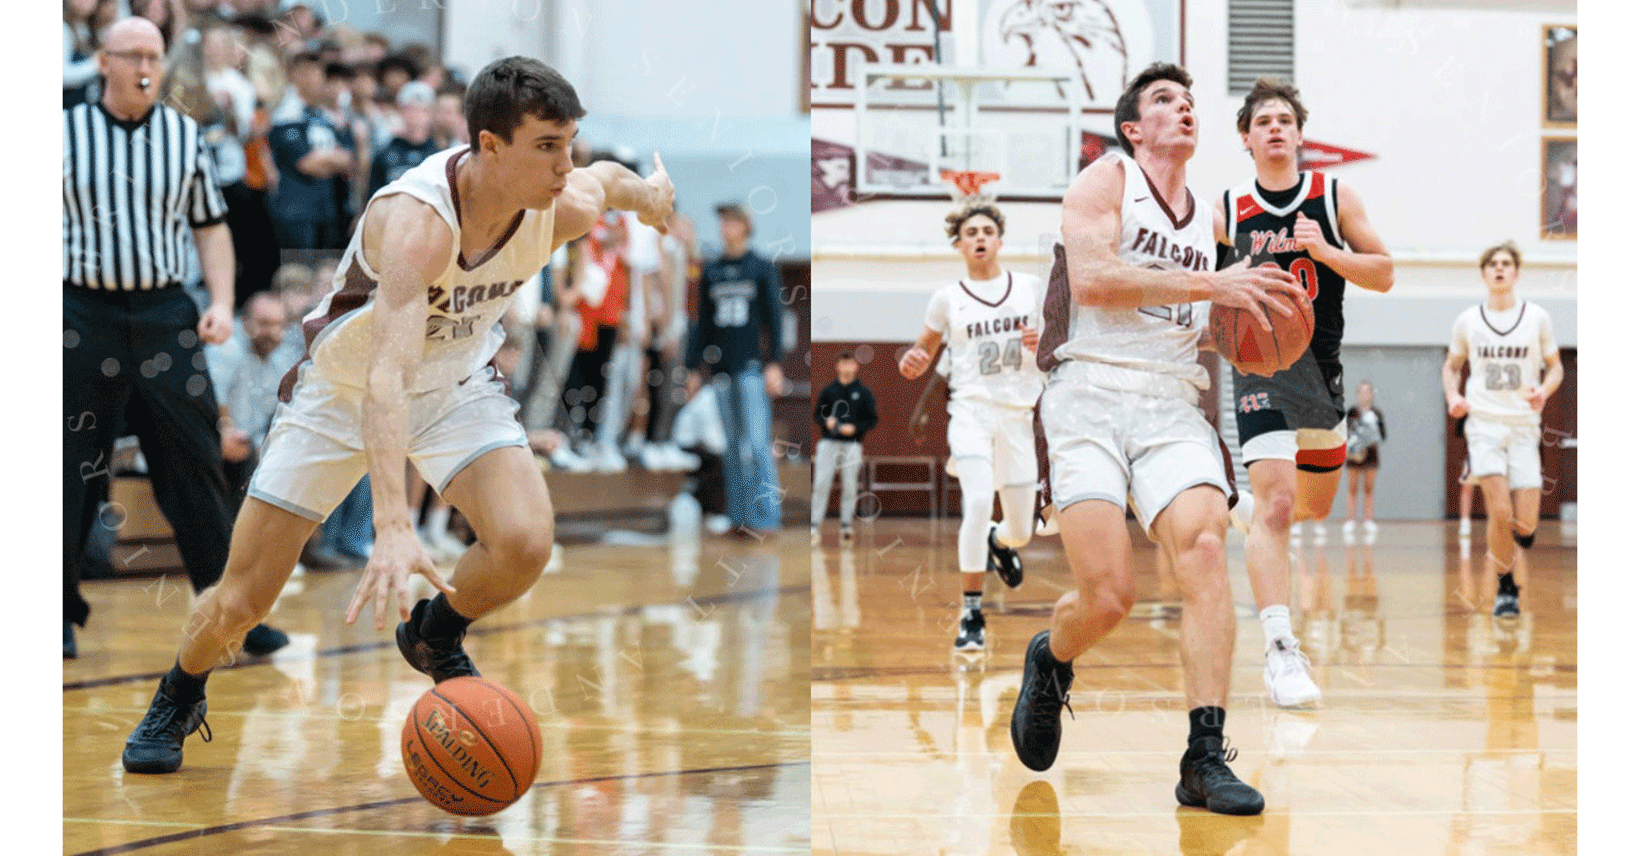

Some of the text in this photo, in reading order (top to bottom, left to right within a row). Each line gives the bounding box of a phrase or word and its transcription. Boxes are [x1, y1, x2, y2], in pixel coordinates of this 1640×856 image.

[811, 43, 935, 91] DE
[978, 337, 1023, 376] 24
[420, 709, 496, 789] SPALDING
